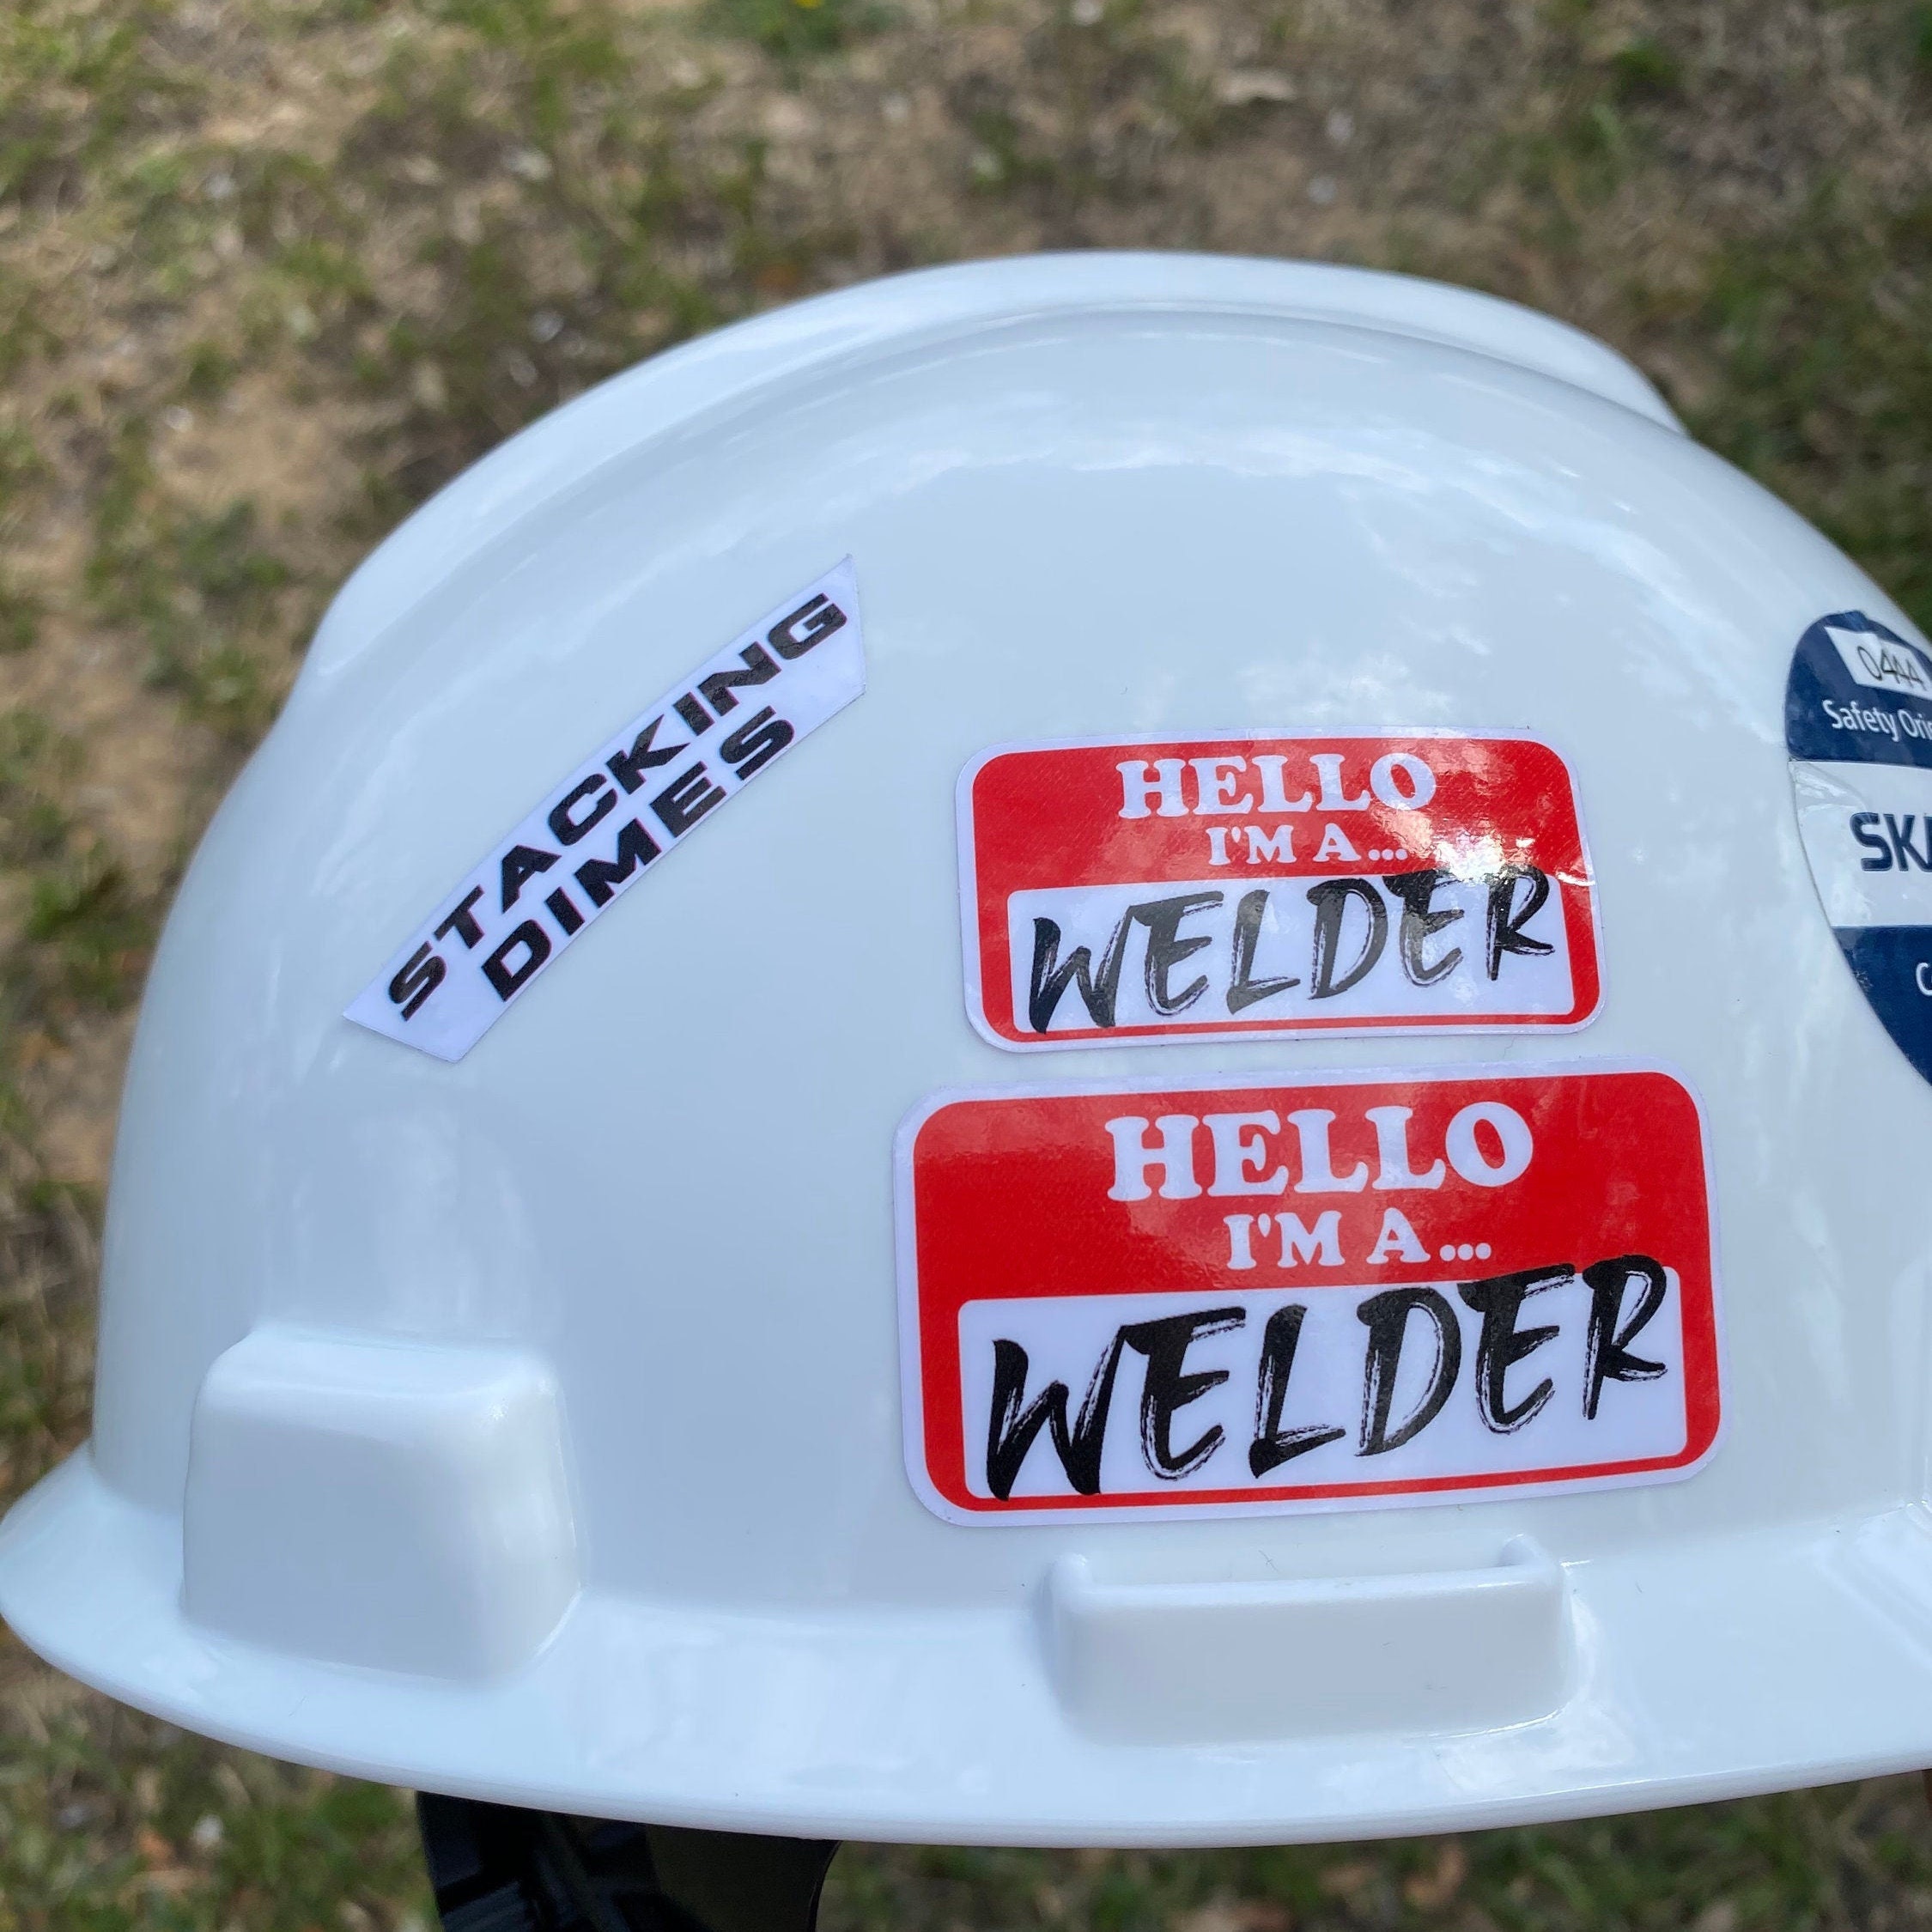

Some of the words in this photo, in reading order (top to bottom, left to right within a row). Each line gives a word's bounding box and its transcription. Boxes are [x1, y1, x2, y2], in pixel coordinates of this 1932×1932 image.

[1822, 699, 1899, 743] Safety
[388, 592, 848, 1022] STACKING
[1115, 752, 1437, 819] HELLO
[480, 705, 795, 1002] DIMES
[1206, 824, 1295, 866] I'M
[1849, 811, 1932, 873] SK
[1029, 864, 1557, 1036] WELDER
[1104, 1101, 1534, 1202] HELLO
[1223, 1210, 1343, 1271] I'M
[986, 1254, 1669, 1502] WELDER
